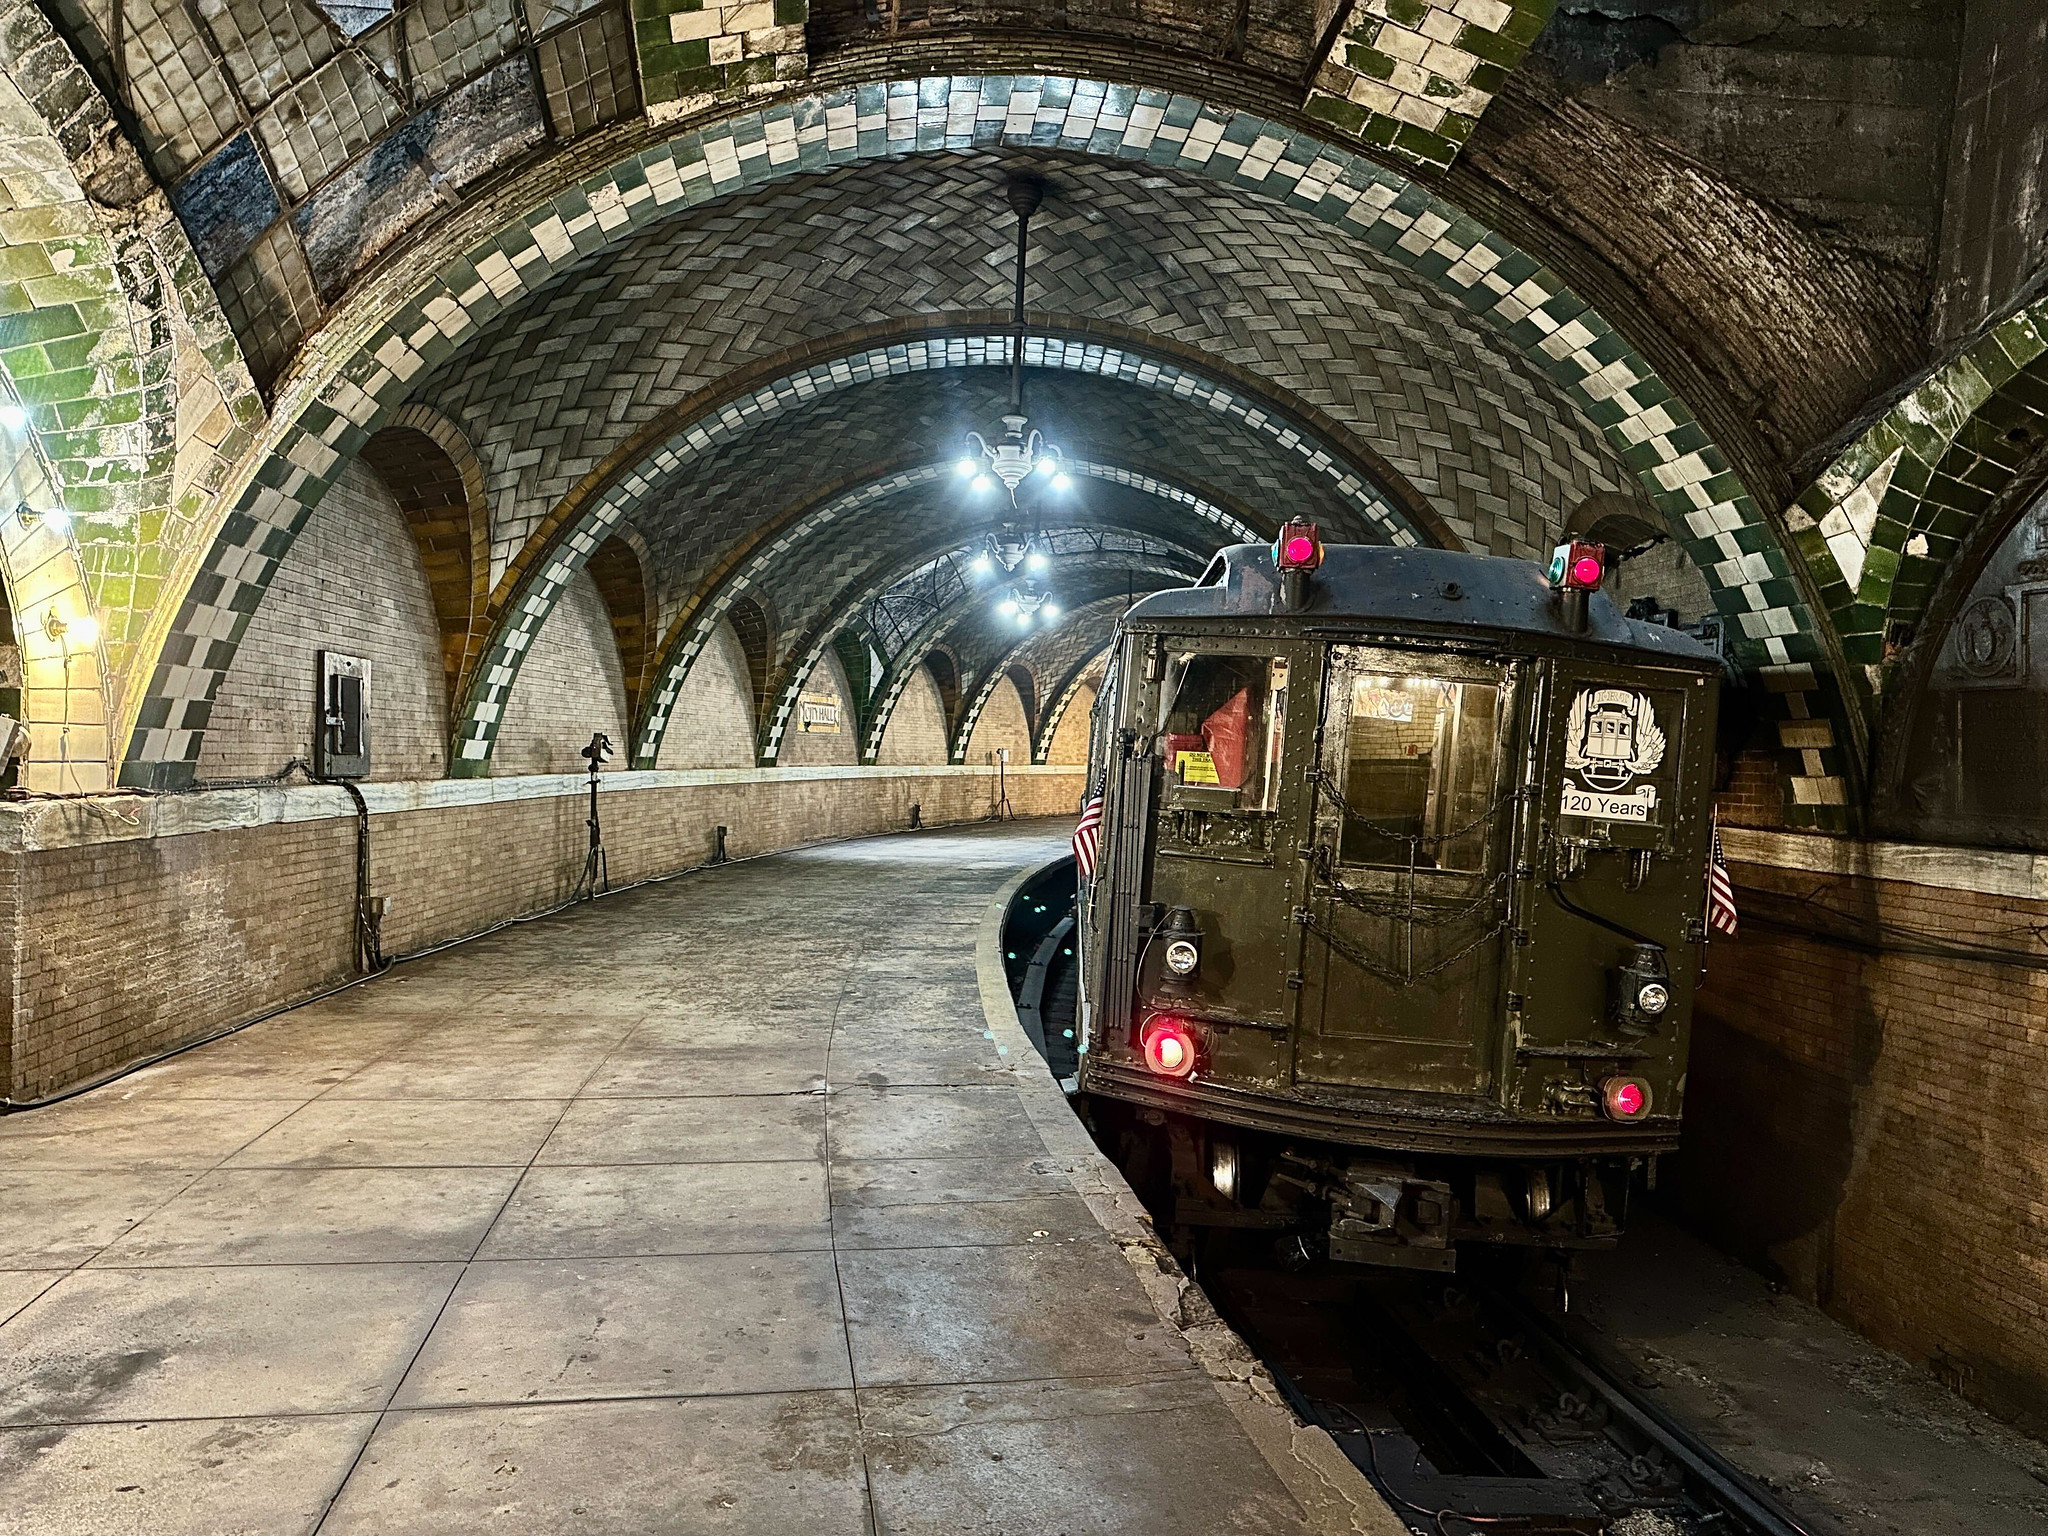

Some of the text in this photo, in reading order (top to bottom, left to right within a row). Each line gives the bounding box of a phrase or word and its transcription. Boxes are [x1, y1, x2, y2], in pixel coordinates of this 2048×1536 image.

[804, 706, 834, 722] CITY HALL
[1562, 795, 1645, 816] 120 Years
